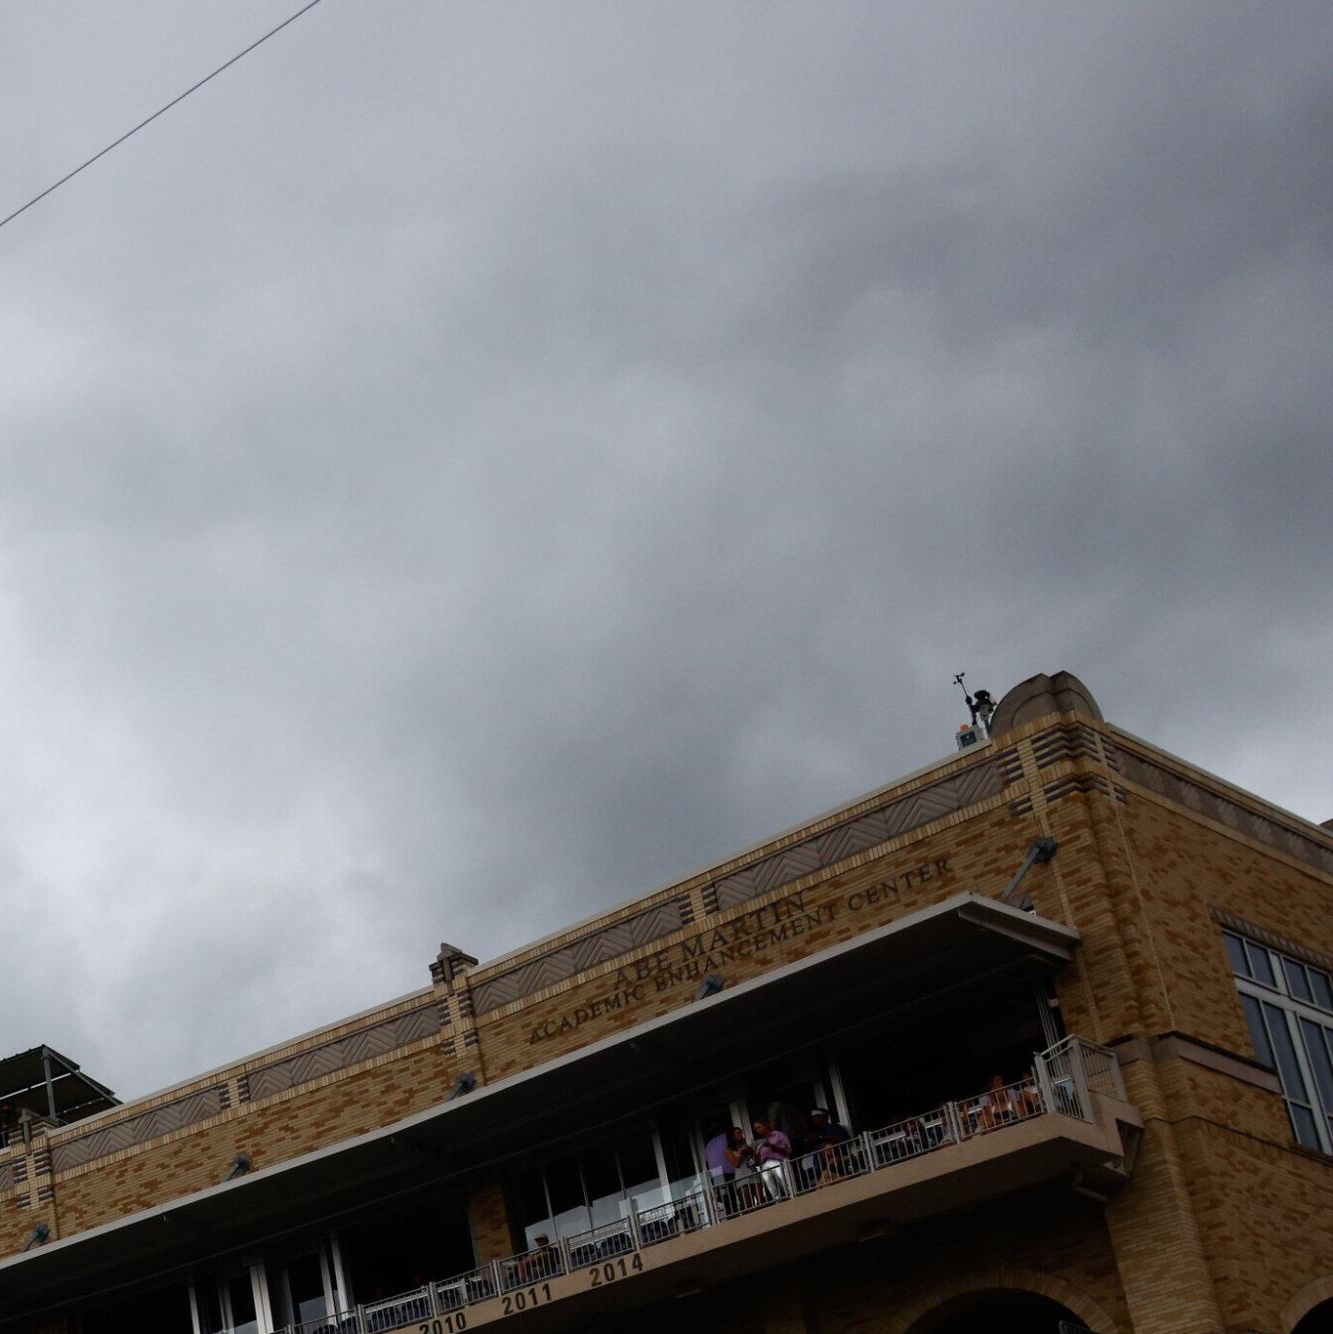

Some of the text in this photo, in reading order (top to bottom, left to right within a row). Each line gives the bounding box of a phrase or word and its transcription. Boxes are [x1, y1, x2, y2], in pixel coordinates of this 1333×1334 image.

[529, 858, 953, 1045] ACADEMIC ENHANCEMENT CENTER
[614, 891, 805, 991] ABE MARTIN
[501, 1284, 552, 1315] 2011
[589, 1253, 643, 1287] 2014
